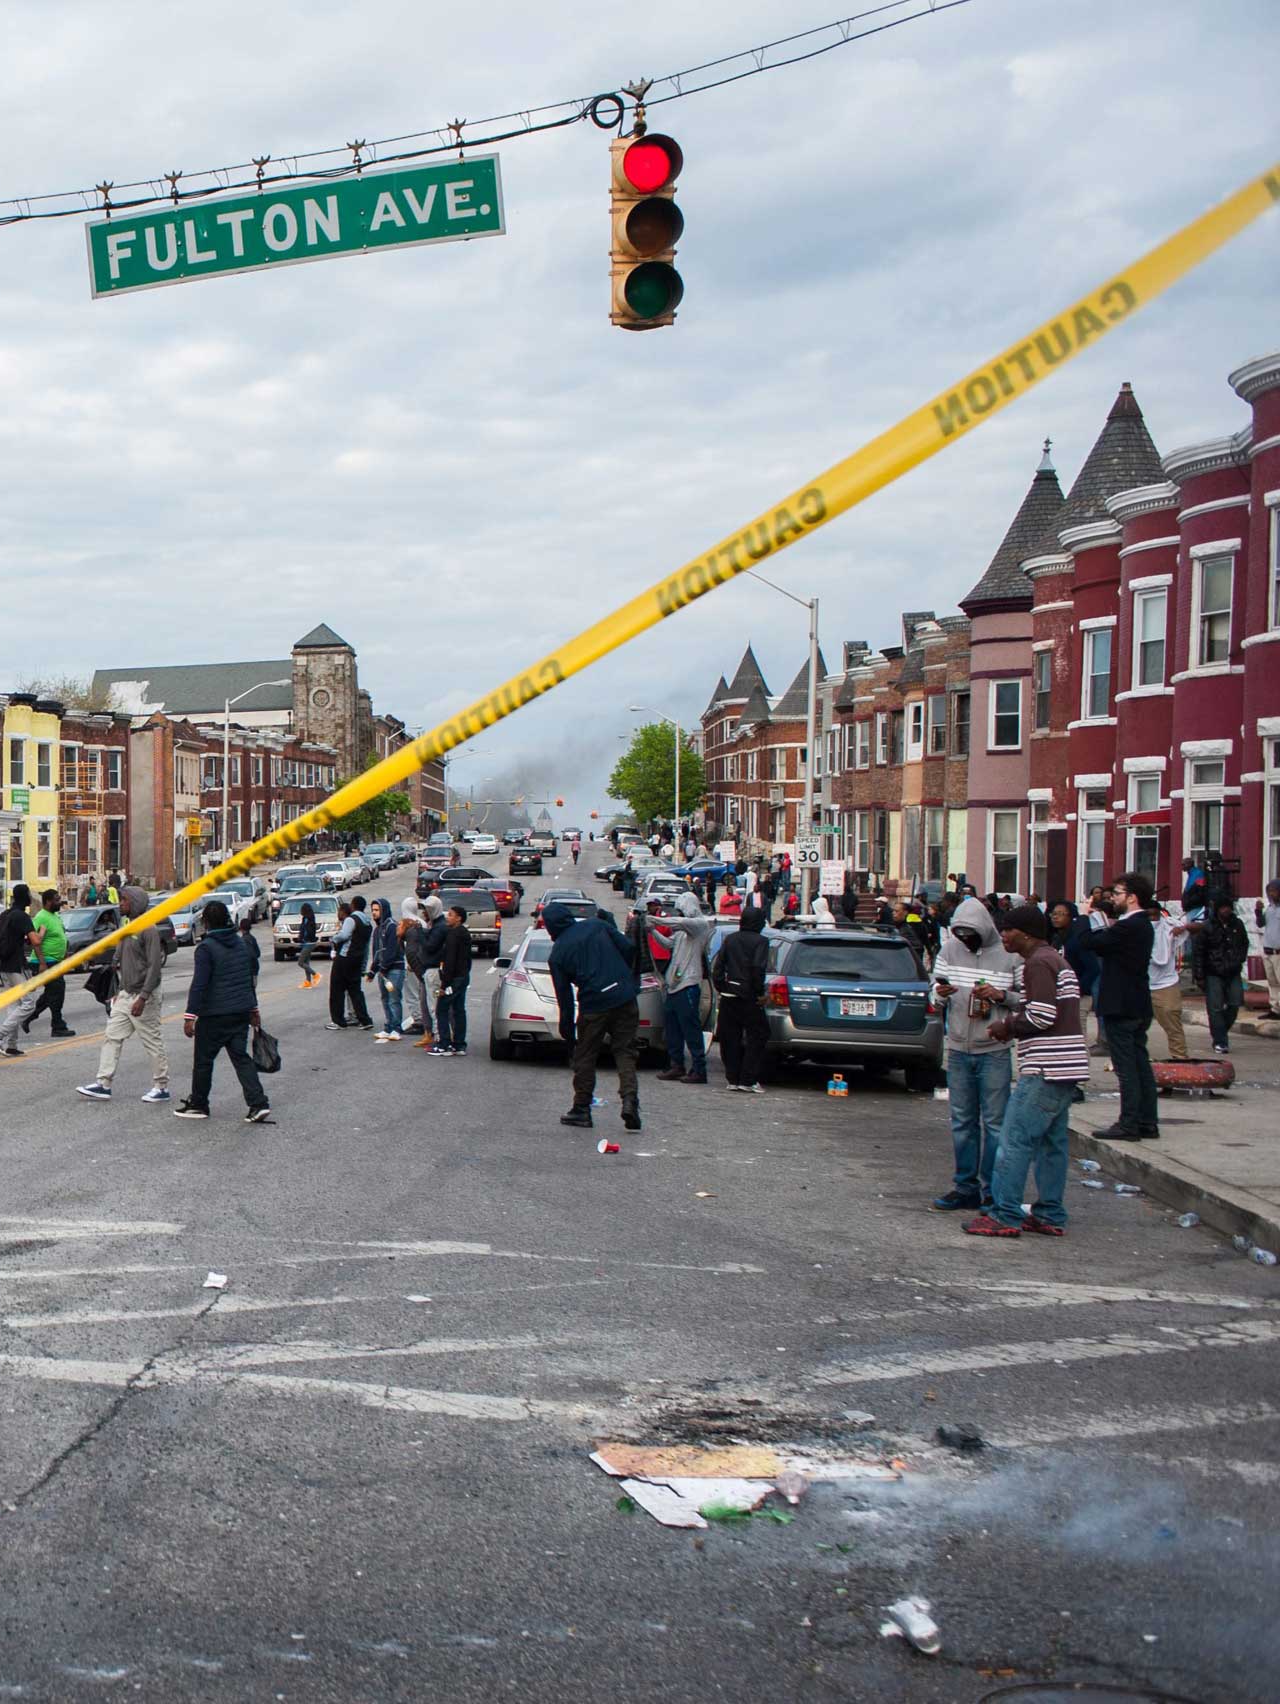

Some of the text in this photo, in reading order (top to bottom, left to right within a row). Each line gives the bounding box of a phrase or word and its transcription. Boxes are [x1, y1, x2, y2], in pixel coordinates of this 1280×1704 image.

[107, 179, 491, 279] FULTON AVE.
[798, 850, 819, 863] 30
